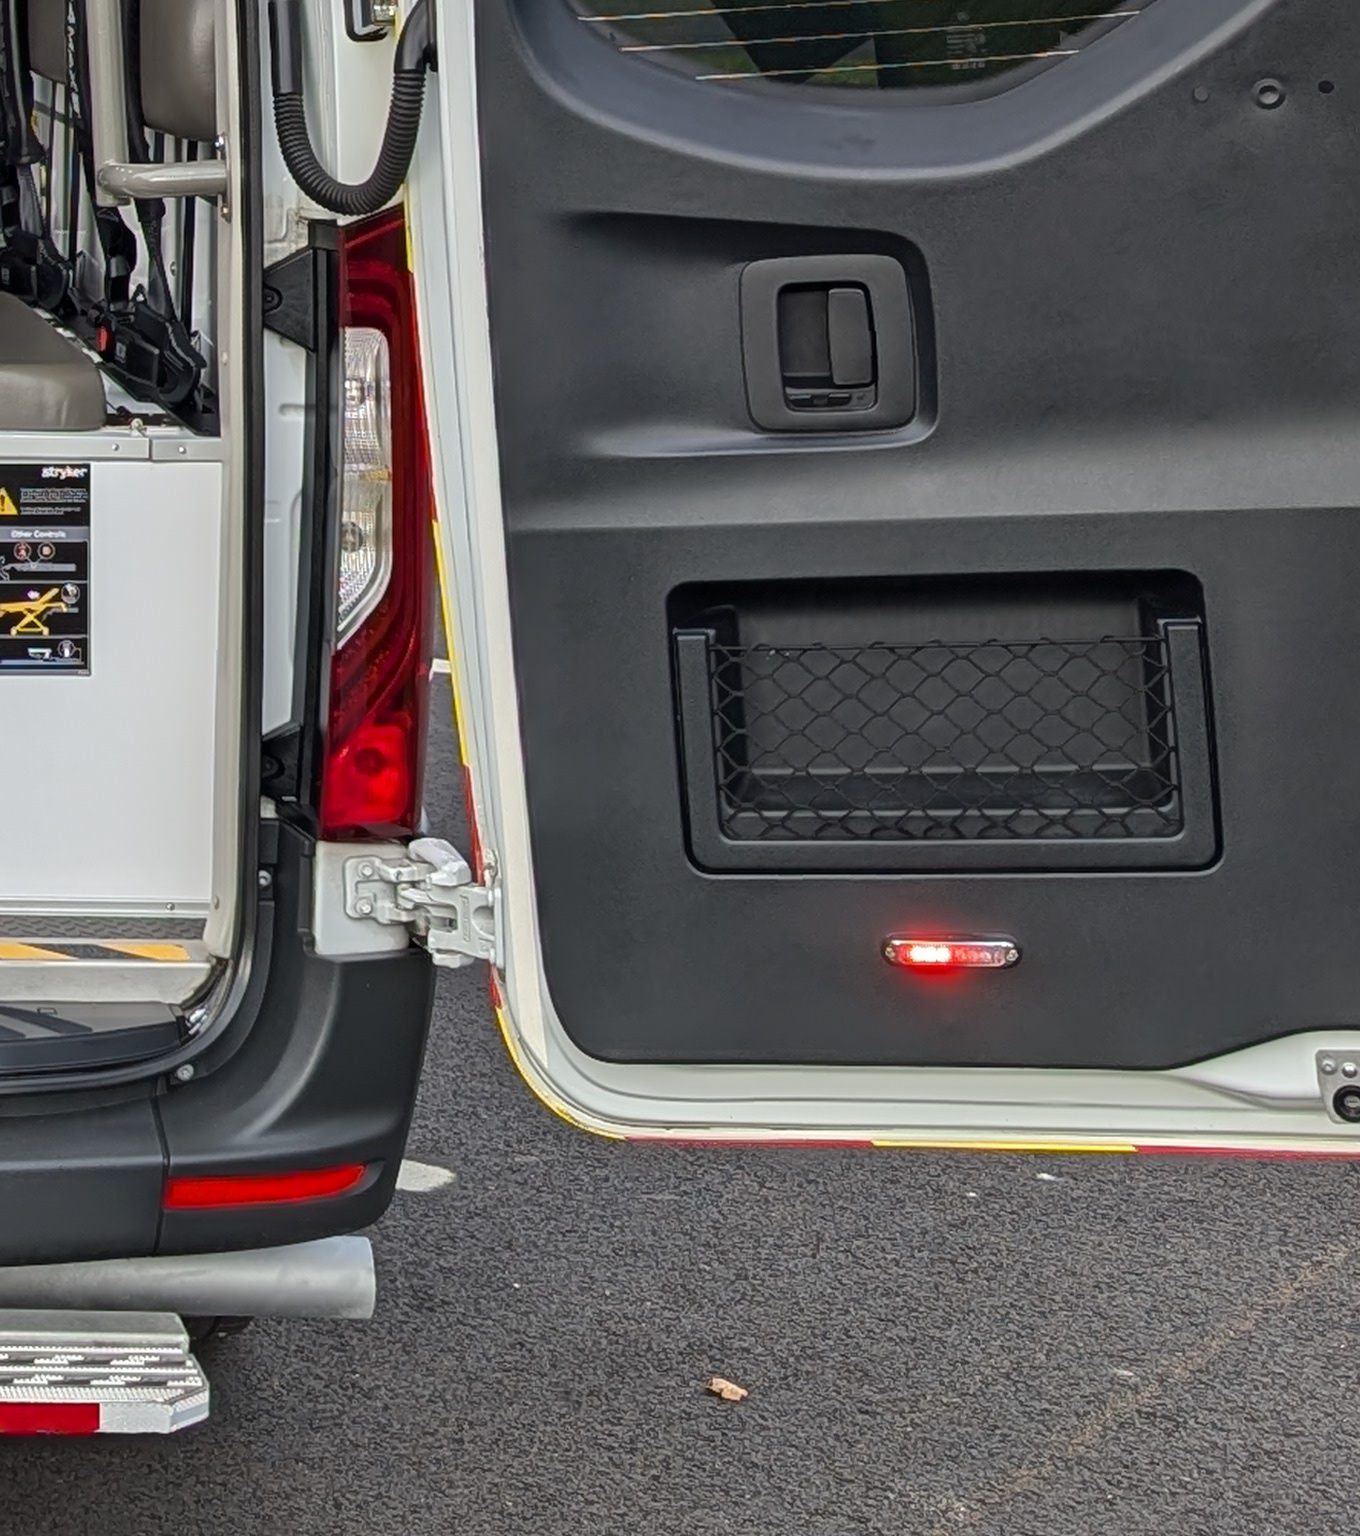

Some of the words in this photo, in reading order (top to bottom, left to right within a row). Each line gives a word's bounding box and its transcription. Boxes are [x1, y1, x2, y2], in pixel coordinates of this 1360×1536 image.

[41, 466, 88, 481] stryker
[10, 529, 32, 539] Other
[33, 529, 67, 539] Controls
